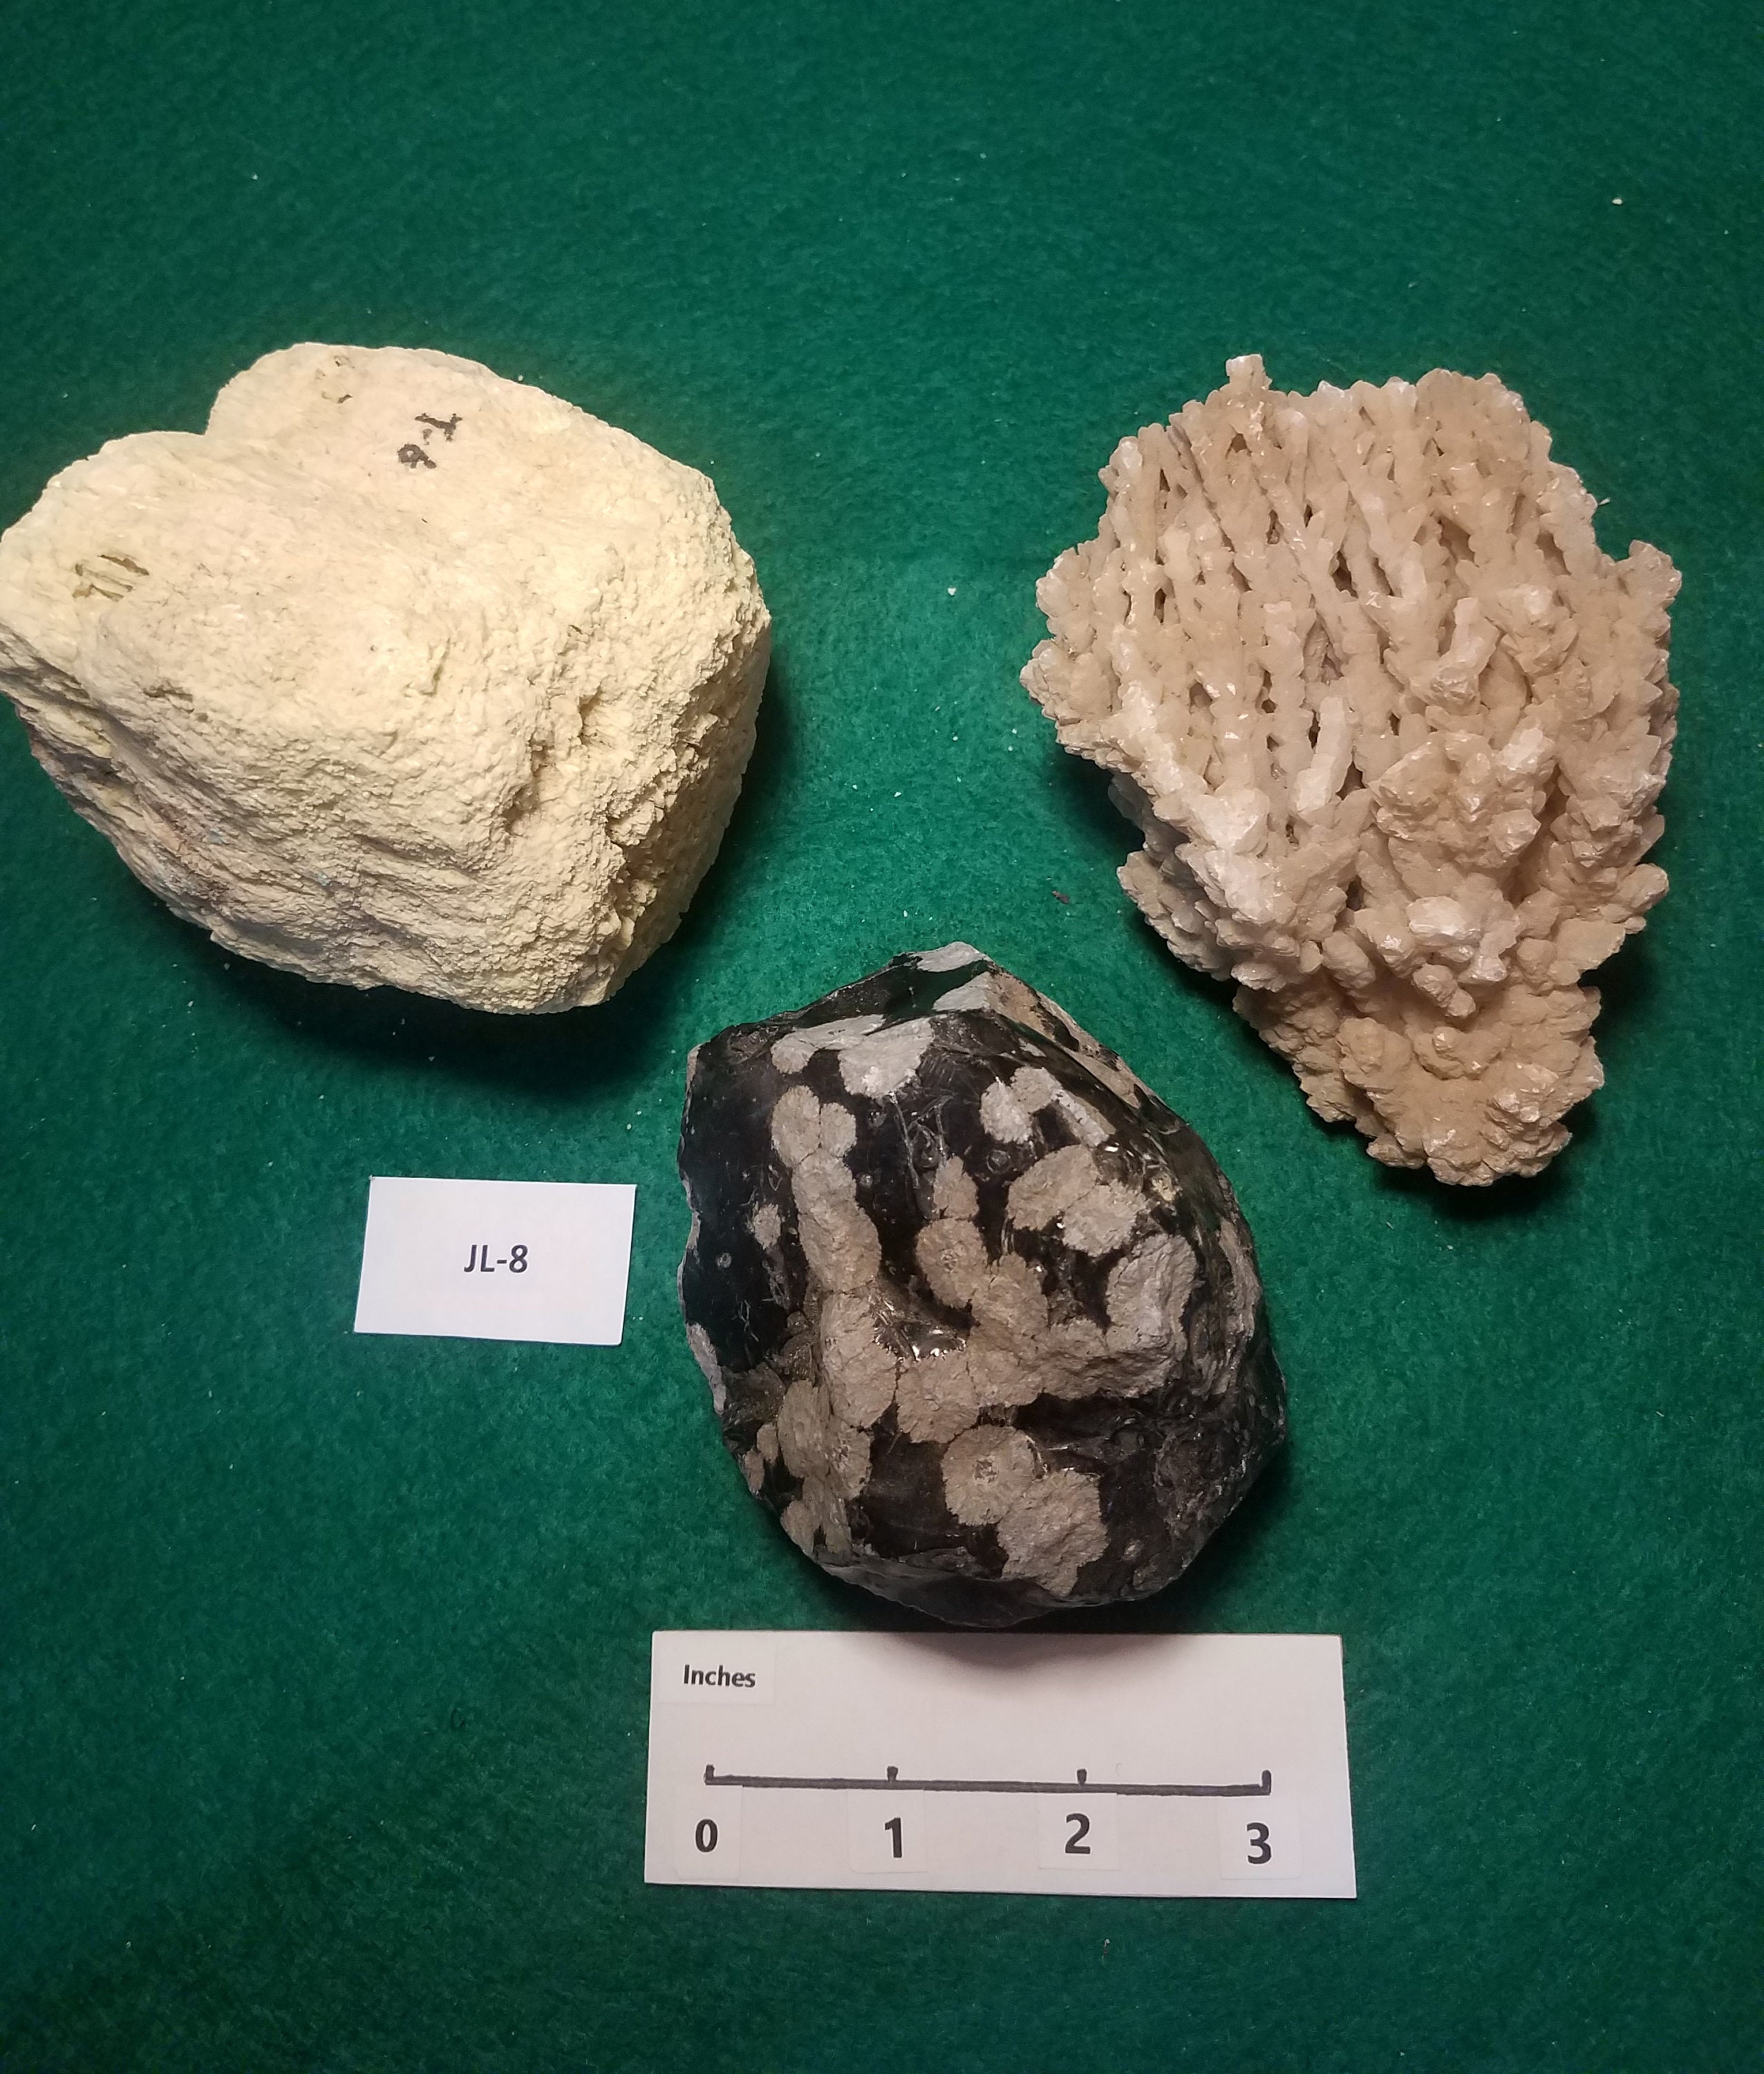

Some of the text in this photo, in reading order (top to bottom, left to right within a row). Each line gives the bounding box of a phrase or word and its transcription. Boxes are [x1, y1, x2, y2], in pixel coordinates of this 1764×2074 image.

[463, 1244, 529, 1273] JL-8
[684, 1664, 756, 1688] Inches
[695, 1813, 1272, 1865] 0 1 2 3
